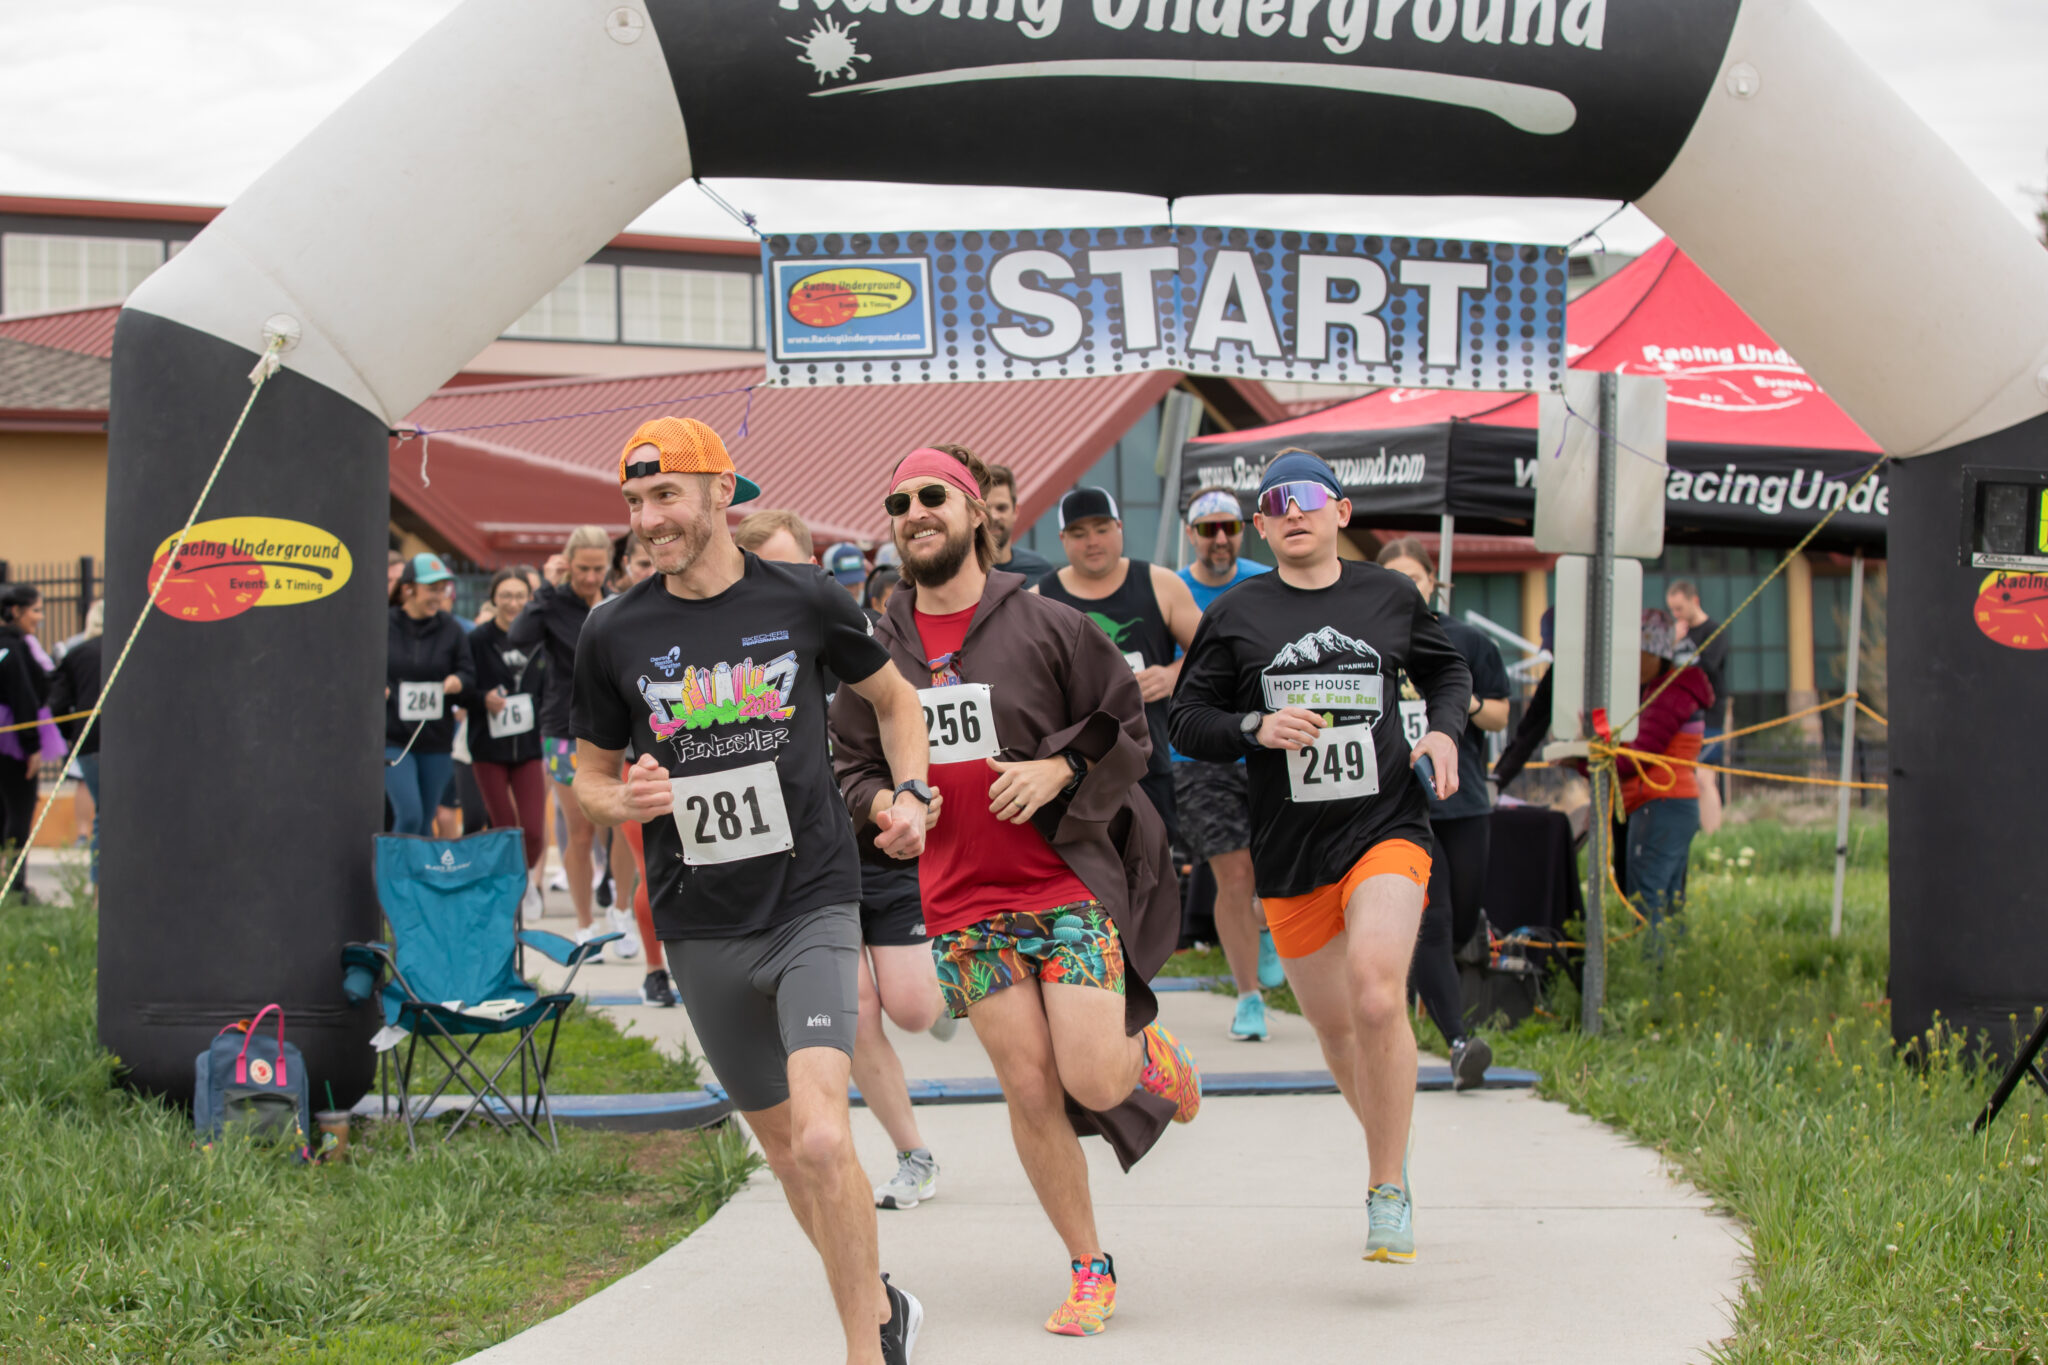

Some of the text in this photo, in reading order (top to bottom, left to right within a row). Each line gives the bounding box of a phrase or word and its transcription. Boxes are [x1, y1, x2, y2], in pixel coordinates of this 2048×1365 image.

[803, 279, 902, 292] Racing Underground
[989, 246, 1489, 367] START
[787, 333, 920, 345] www.RacingUnderground.com
[1642, 344, 1735, 364] Racing
[232, 538, 342, 560] Underground
[230, 578, 323, 594] Events & Timing
[1273, 679, 1360, 691] HOPE HOUSE
[408, 691, 436, 711] 284
[739, 689, 781, 717] 2018
[1287, 693, 1377, 705] 5K & Fun Run
[670, 728, 790, 763] FINISHER
[1300, 741, 1364, 785] 249
[686, 786, 771, 844] 281
